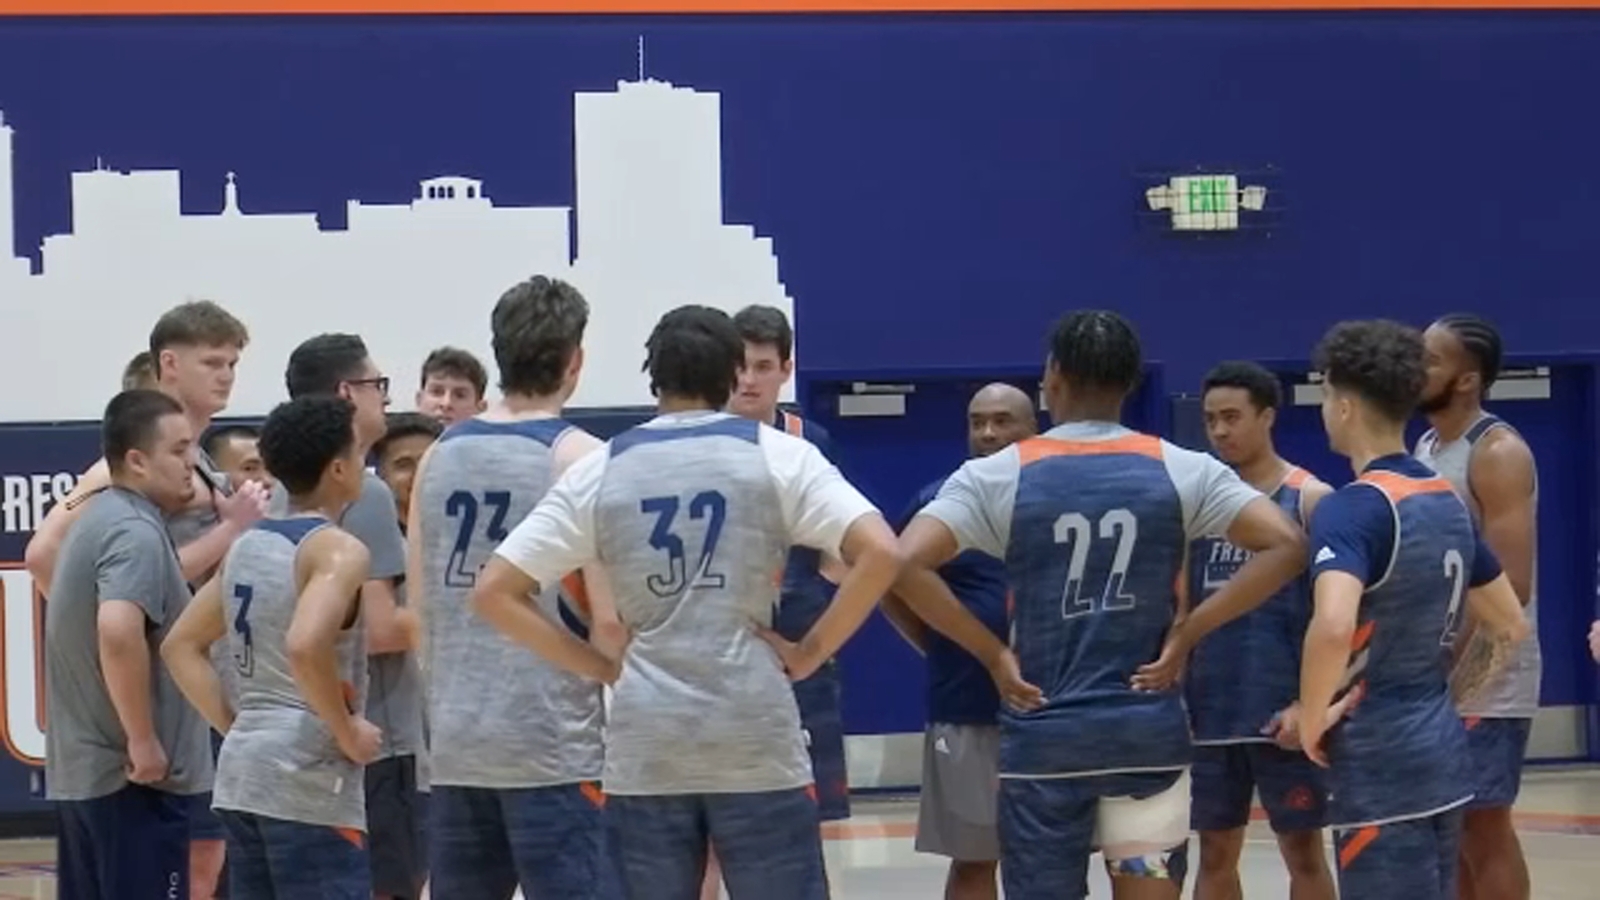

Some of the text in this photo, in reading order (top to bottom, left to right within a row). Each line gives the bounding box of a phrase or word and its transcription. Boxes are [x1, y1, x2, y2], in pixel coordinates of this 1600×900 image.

[1189, 180, 1228, 213] EXIT
[2, 472, 85, 532] RES
[641, 489, 726, 598] 32
[1053, 508, 1137, 619] 22
[1209, 542, 1255, 563] FRE
[1440, 549, 1463, 646] 2
[234, 584, 254, 678] 3
